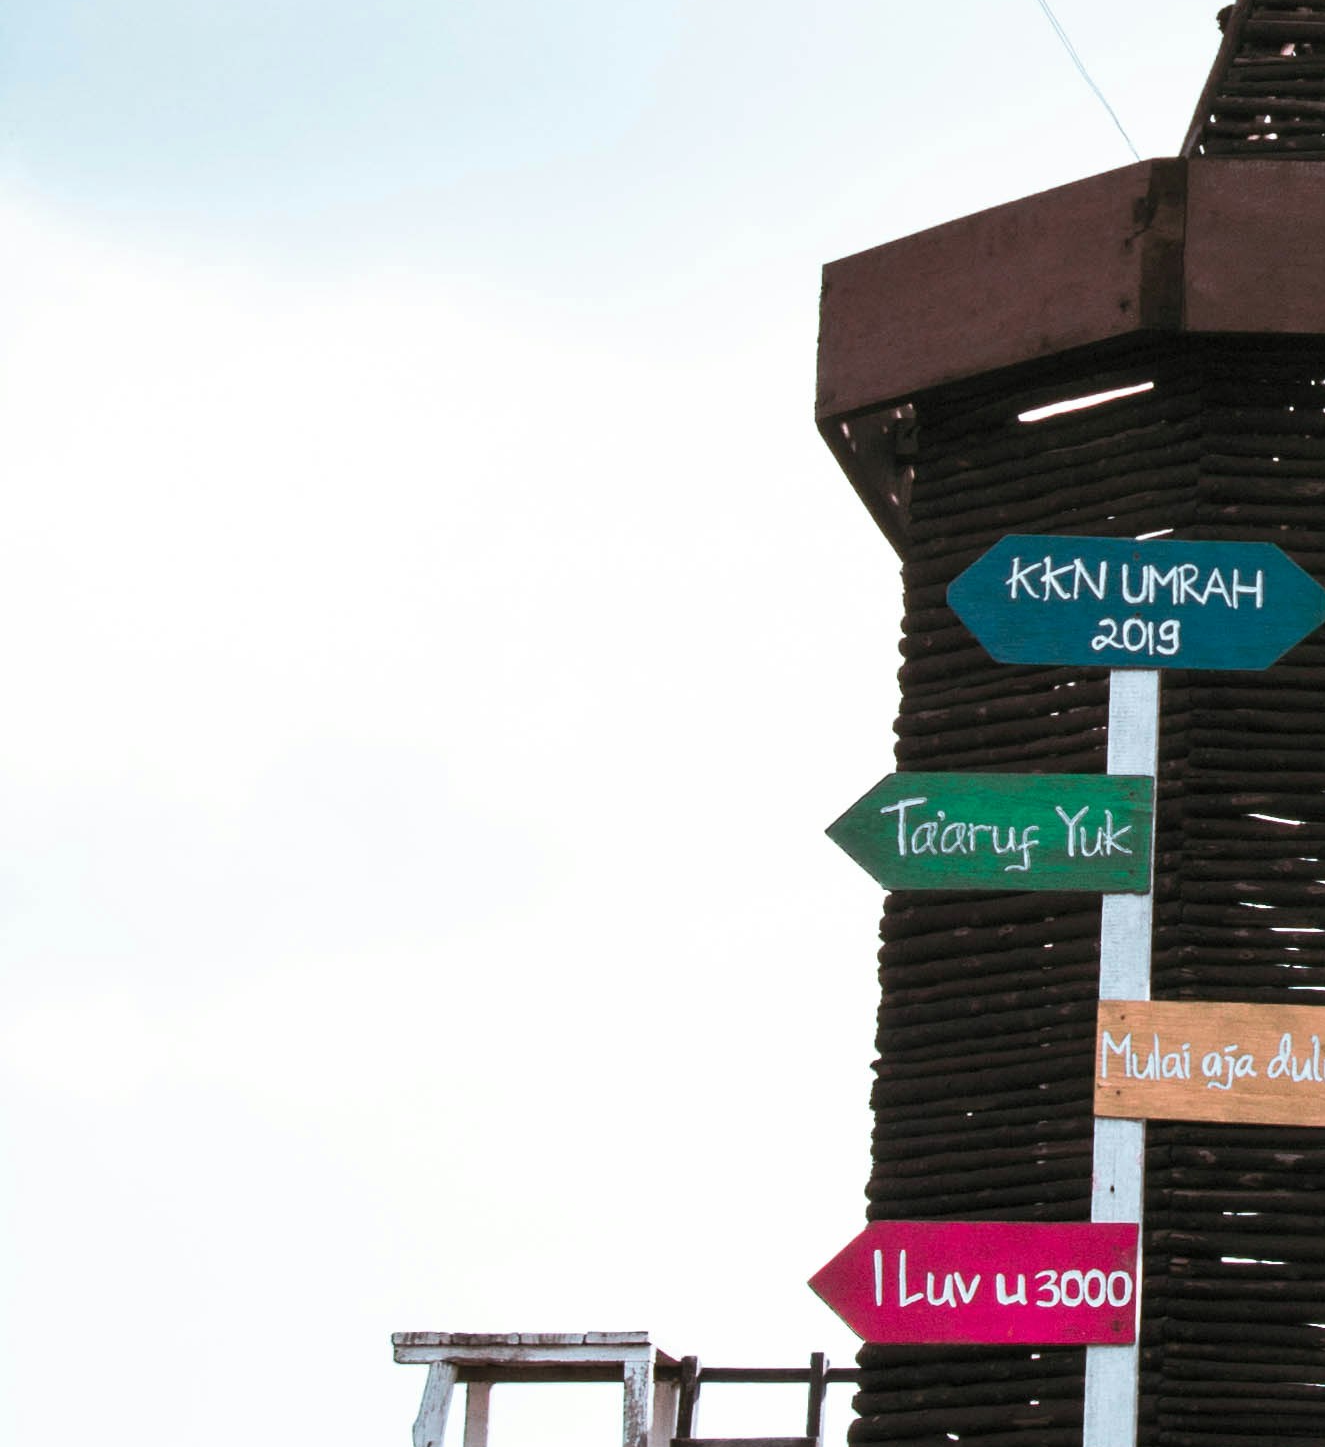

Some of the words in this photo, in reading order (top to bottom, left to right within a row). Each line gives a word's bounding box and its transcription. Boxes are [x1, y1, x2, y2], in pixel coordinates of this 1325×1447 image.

[1006, 556, 1107, 601] KKN
[1122, 564, 1263, 609] UMRAH
[1091, 618, 1181, 655] 2019
[881, 797, 1039, 871] Ta'aruf
[1055, 805, 1132, 857] Yuk
[1101, 1031, 1190, 1080] Mulai
[1202, 1045, 1256, 1089] aja
[899, 1249, 980, 1307] Luv
[995, 1273, 1026, 1305] u
[1035, 1269, 1132, 1307] 3000
